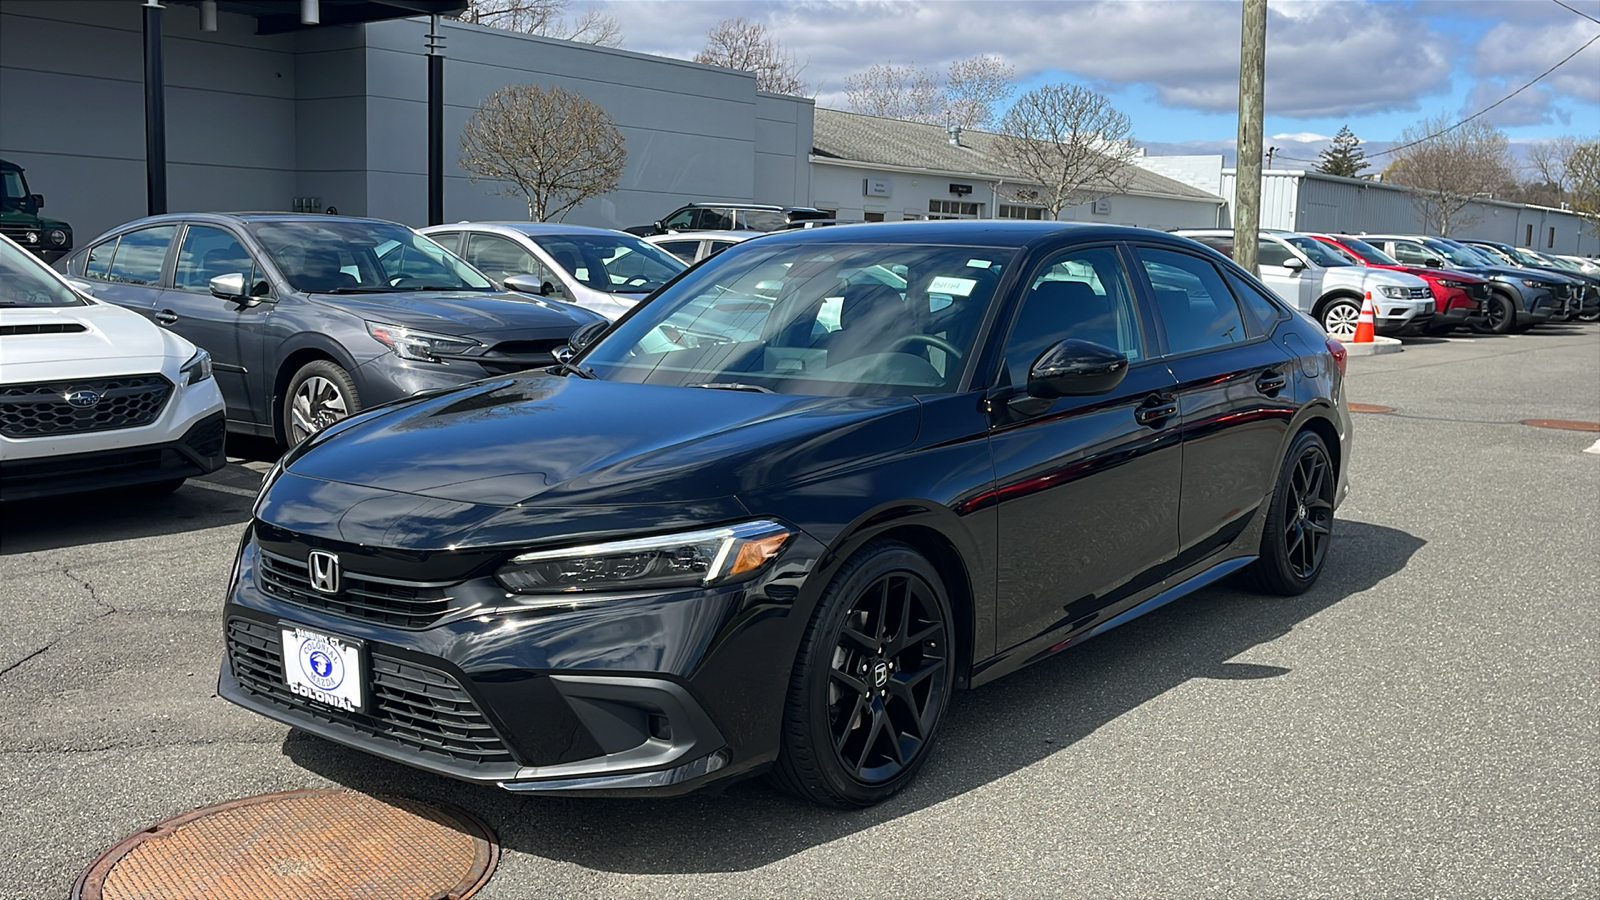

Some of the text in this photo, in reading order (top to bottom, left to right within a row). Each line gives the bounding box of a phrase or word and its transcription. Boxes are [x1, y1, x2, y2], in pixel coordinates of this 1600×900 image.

[303, 640, 338, 664] COLONIAL
[310, 671, 336, 687] MAZDA
[290, 682, 356, 713] COLONIAL
